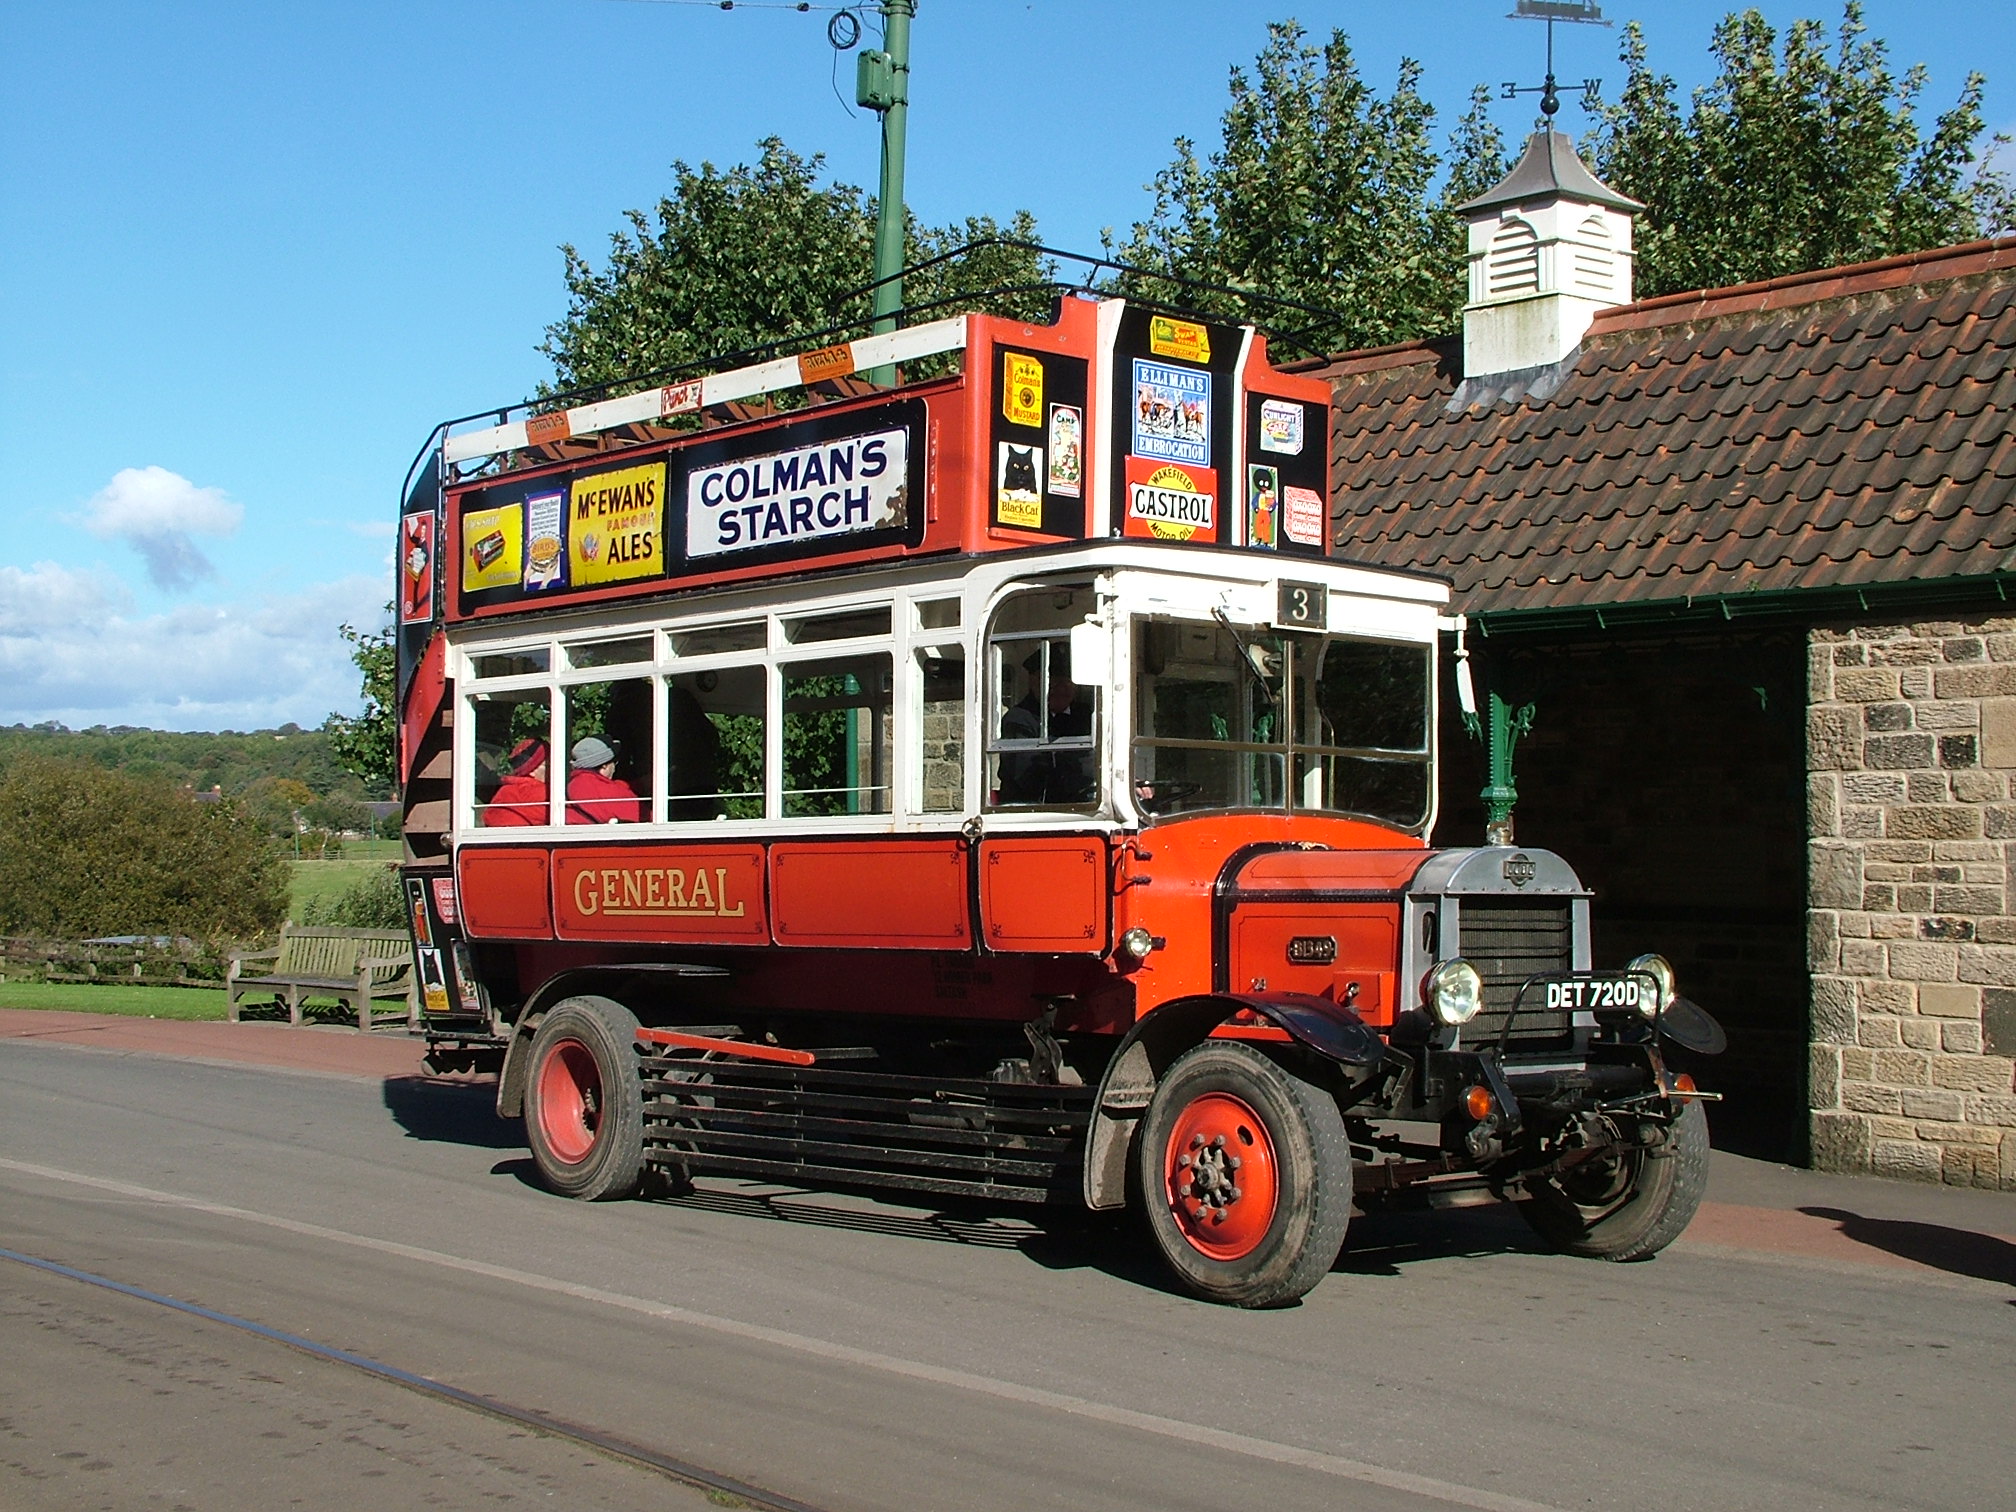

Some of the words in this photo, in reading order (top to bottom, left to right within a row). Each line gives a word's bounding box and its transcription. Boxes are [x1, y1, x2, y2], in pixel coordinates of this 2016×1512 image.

[1583, 79, 1602, 95] W
[1013, 407, 1041, 421] MUSTARD
[1263, 410, 1296, 424] SUNLIGHT
[1138, 436, 1205, 461] EMBROCATION
[701, 440, 887, 508] COLMAN'S
[1151, 468, 1193, 490] WAKEFIELD
[718, 485, 870, 546] STARCH
[1001, 501, 1025, 515] Black
[1025, 504, 1039, 516] Cat
[1135, 488, 1210, 524] CASTROL
[1179, 527, 1193, 542] OIL
[606, 531, 654, 566] ALES
[1291, 587, 1309, 621] 3
[574, 867, 745, 918] GENERAL
[1547, 982, 1586, 1009] DET
[1589, 980, 1639, 1007] 720D
